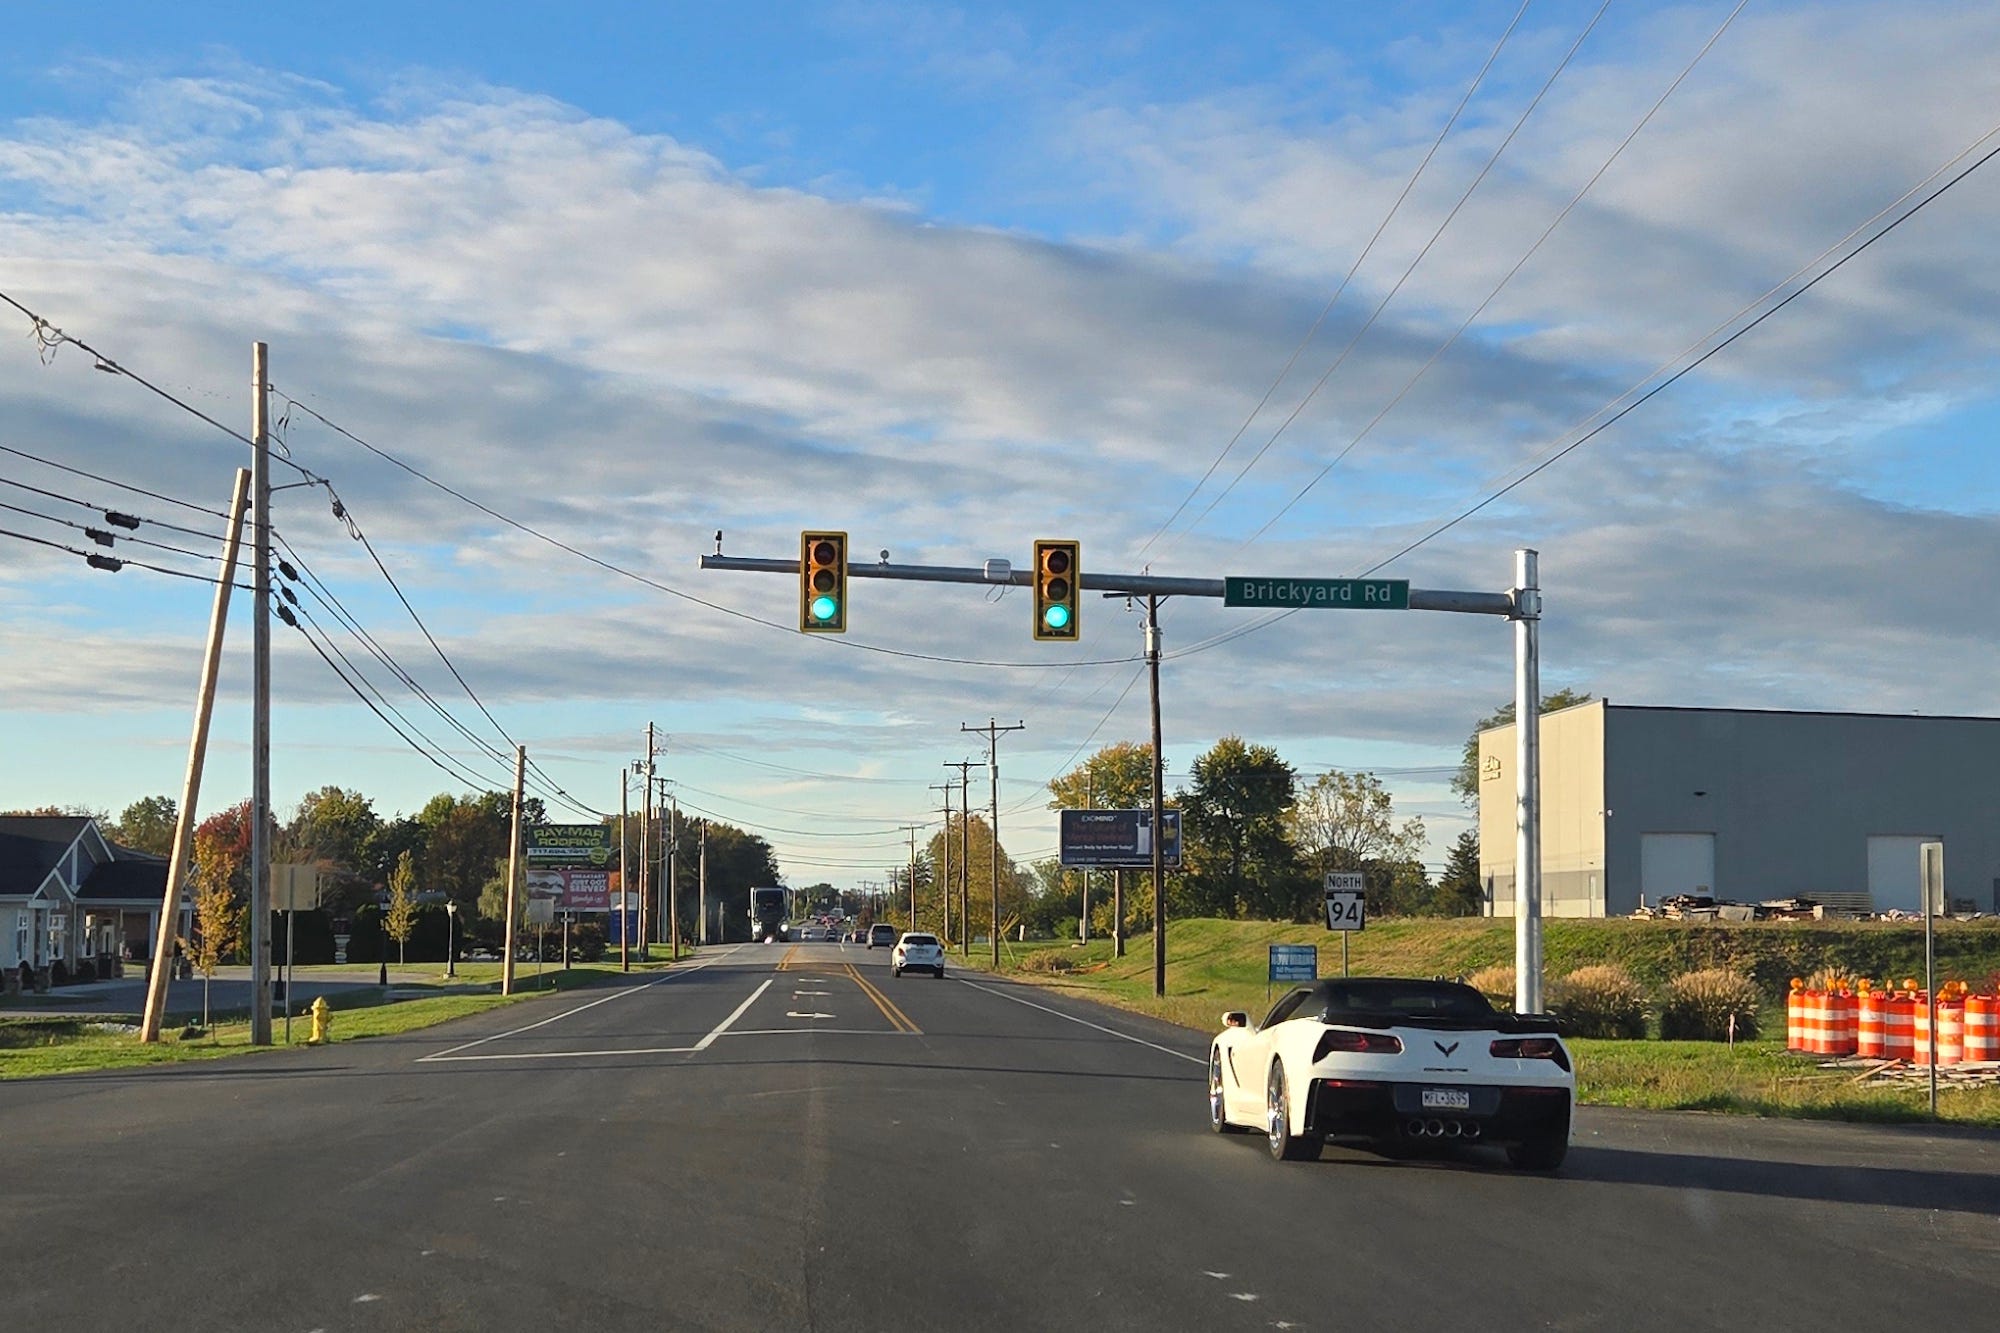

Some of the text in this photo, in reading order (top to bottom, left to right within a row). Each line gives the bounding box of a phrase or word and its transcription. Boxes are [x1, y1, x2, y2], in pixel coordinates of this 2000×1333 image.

[1243, 582, 1391, 604] Brickyard Rd
[533, 827, 605, 838] RAY-MAR
[538, 838, 601, 846] ROOFING
[1328, 875, 1361, 888] NORTH
[1332, 902, 1359, 923] 94
